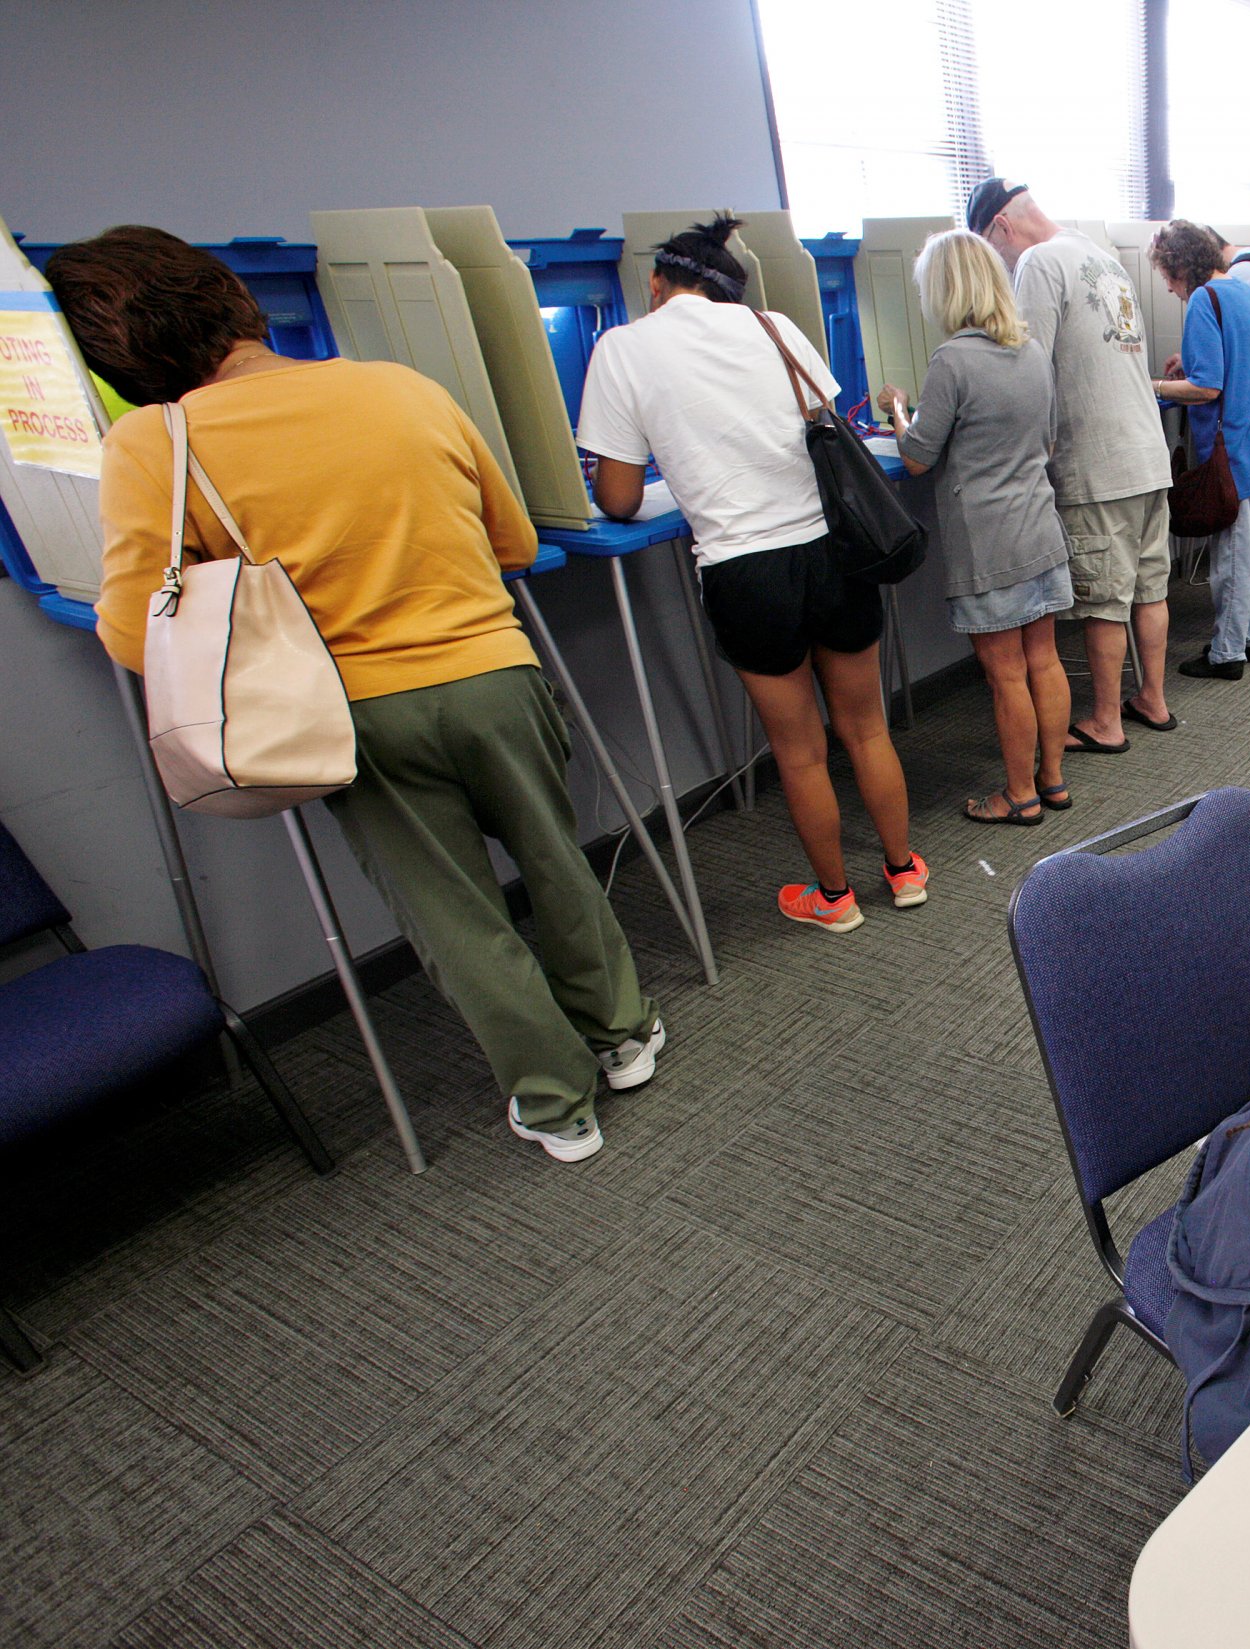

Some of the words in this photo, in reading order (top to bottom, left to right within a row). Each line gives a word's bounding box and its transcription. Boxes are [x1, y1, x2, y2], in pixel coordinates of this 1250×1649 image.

[0, 336, 52, 366] OTING
[22, 374, 46, 401] IN
[8, 408, 89, 443] PROCESS
